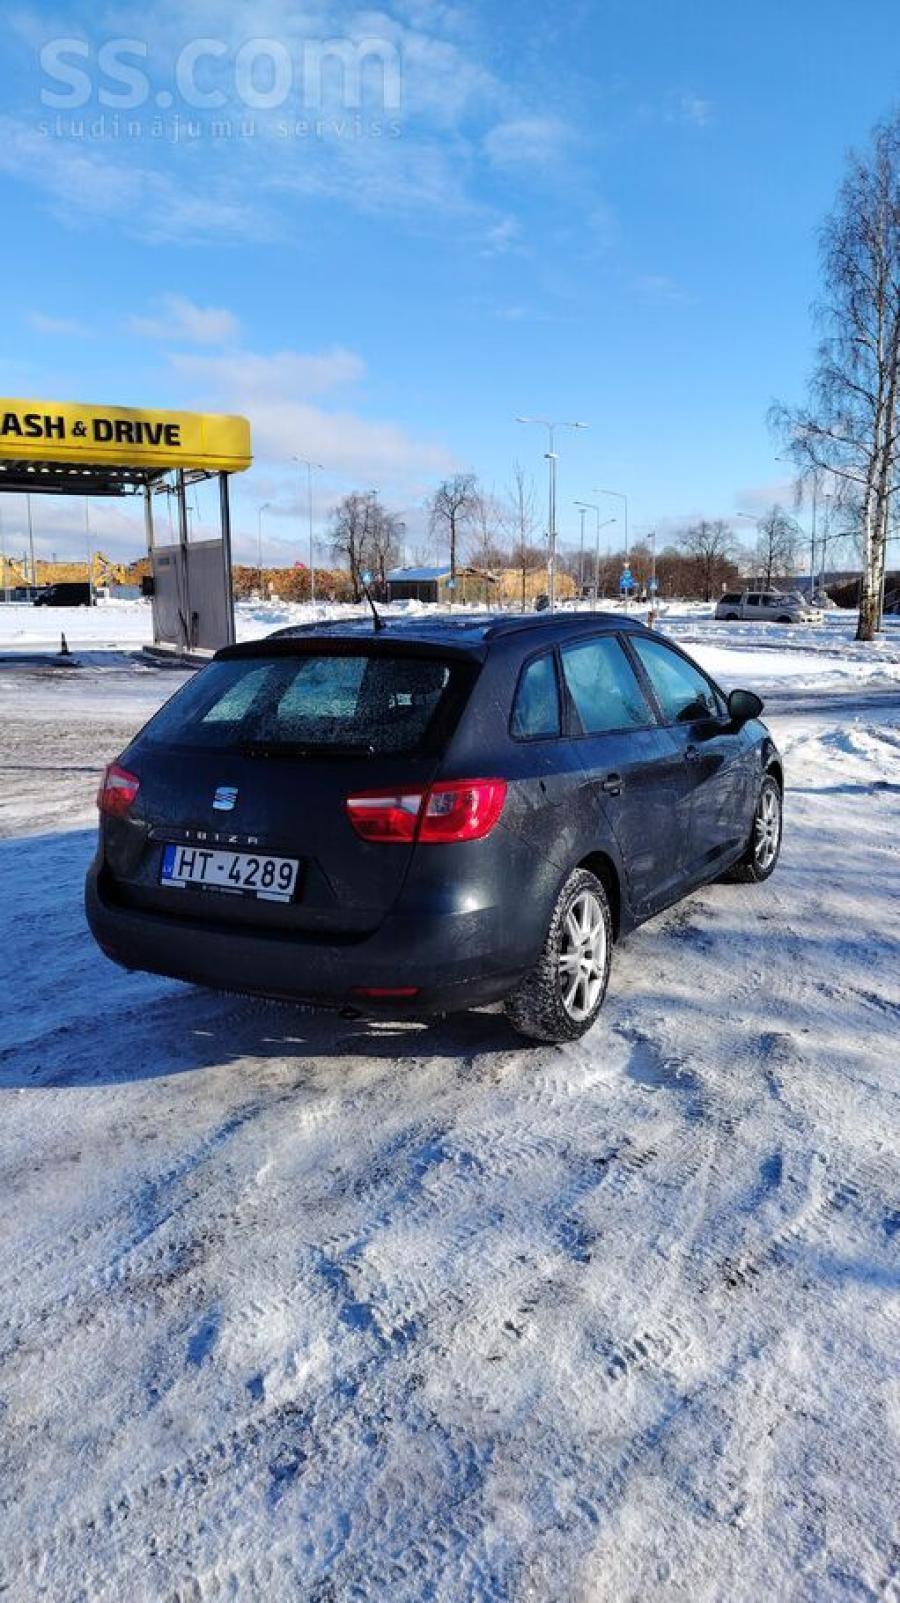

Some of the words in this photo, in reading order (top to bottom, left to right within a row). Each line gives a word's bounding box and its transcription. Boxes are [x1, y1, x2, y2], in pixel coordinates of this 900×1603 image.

[72, 420, 87, 437] &
[92, 418, 181, 446] DRIVE
[177, 849, 293, 890] HT-4289
